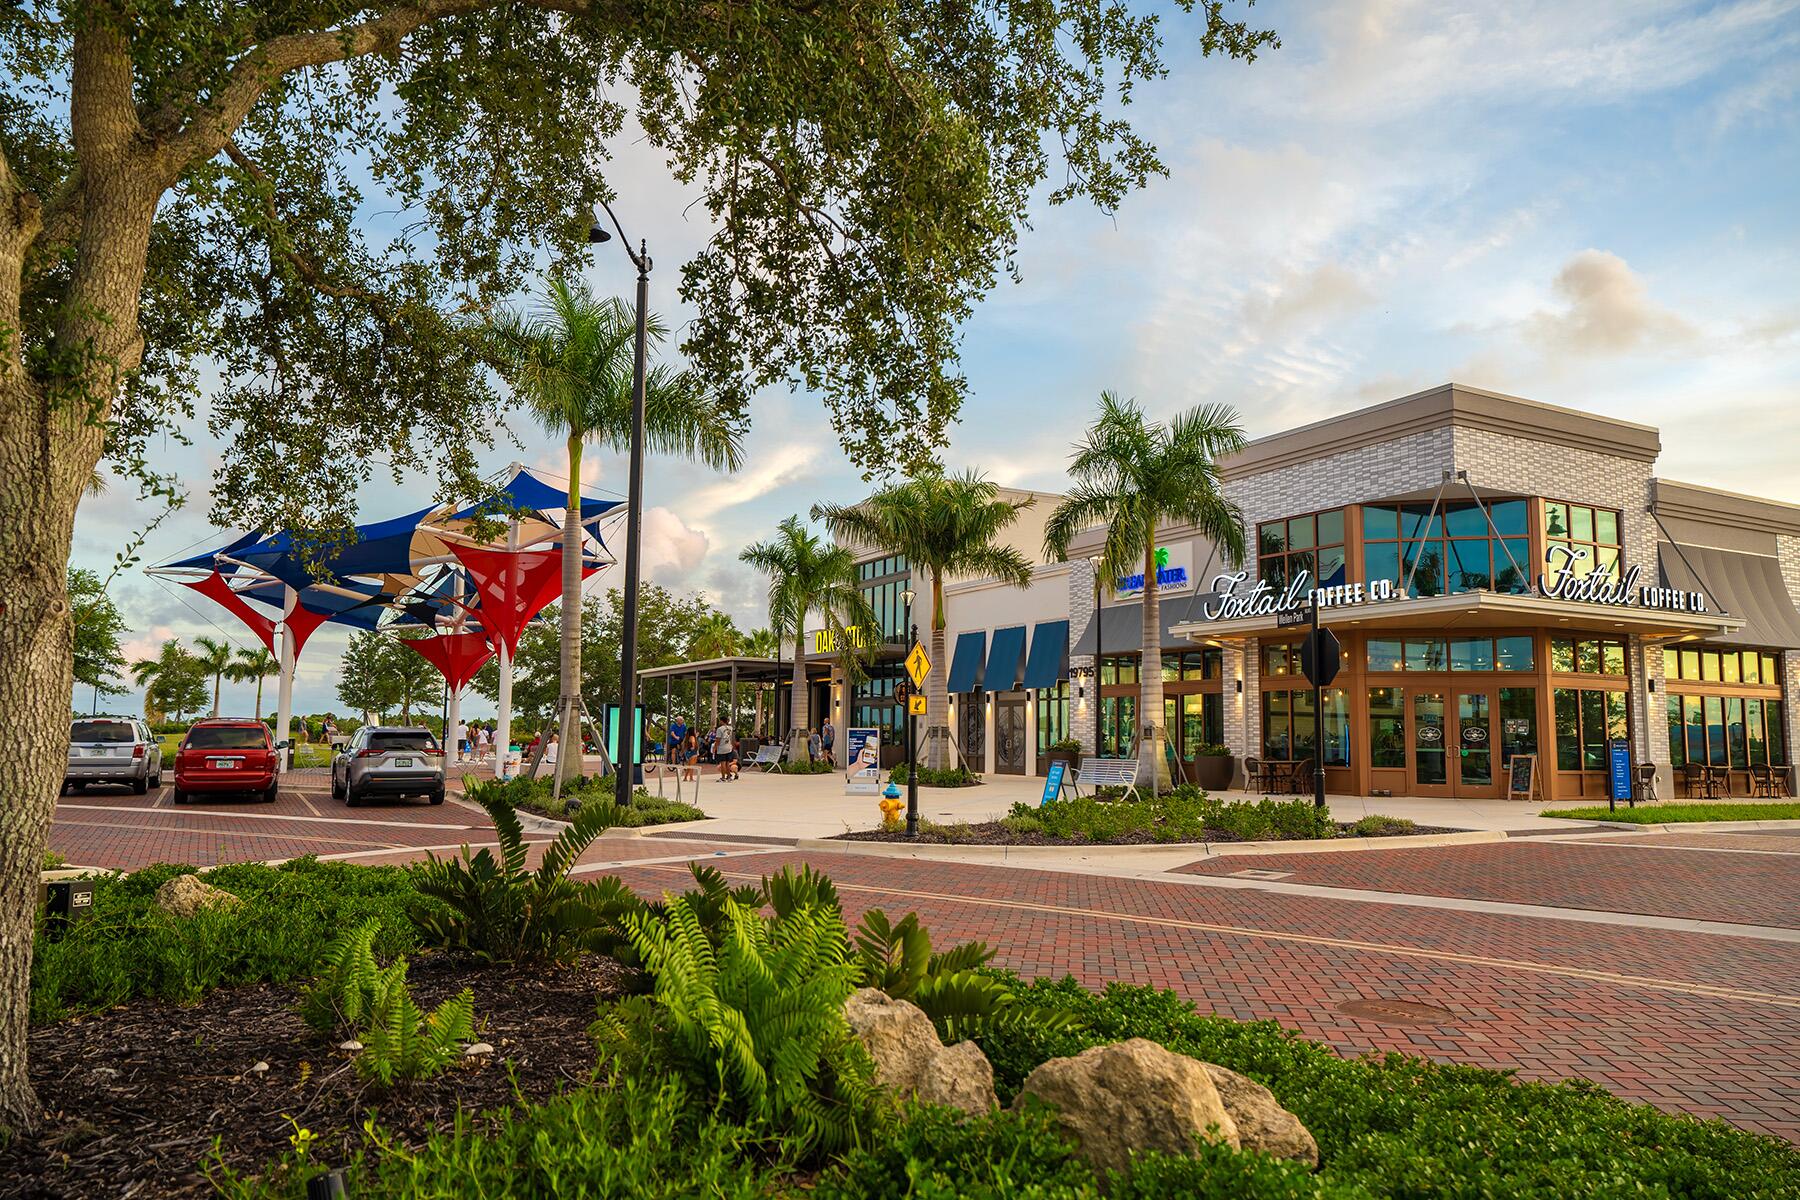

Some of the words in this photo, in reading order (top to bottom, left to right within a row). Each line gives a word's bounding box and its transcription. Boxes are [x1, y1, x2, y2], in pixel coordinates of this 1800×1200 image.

[1204, 570, 1308, 619] Foxtail
[1371, 578, 1398, 600] CO.
[1539, 545, 1641, 604] Foxtail
[1641, 587, 1685, 609] COFFEE
[1689, 592, 1709, 612] CO.
[815, 630, 835, 654] OAK
[1069, 667, 1094, 678] 19795
